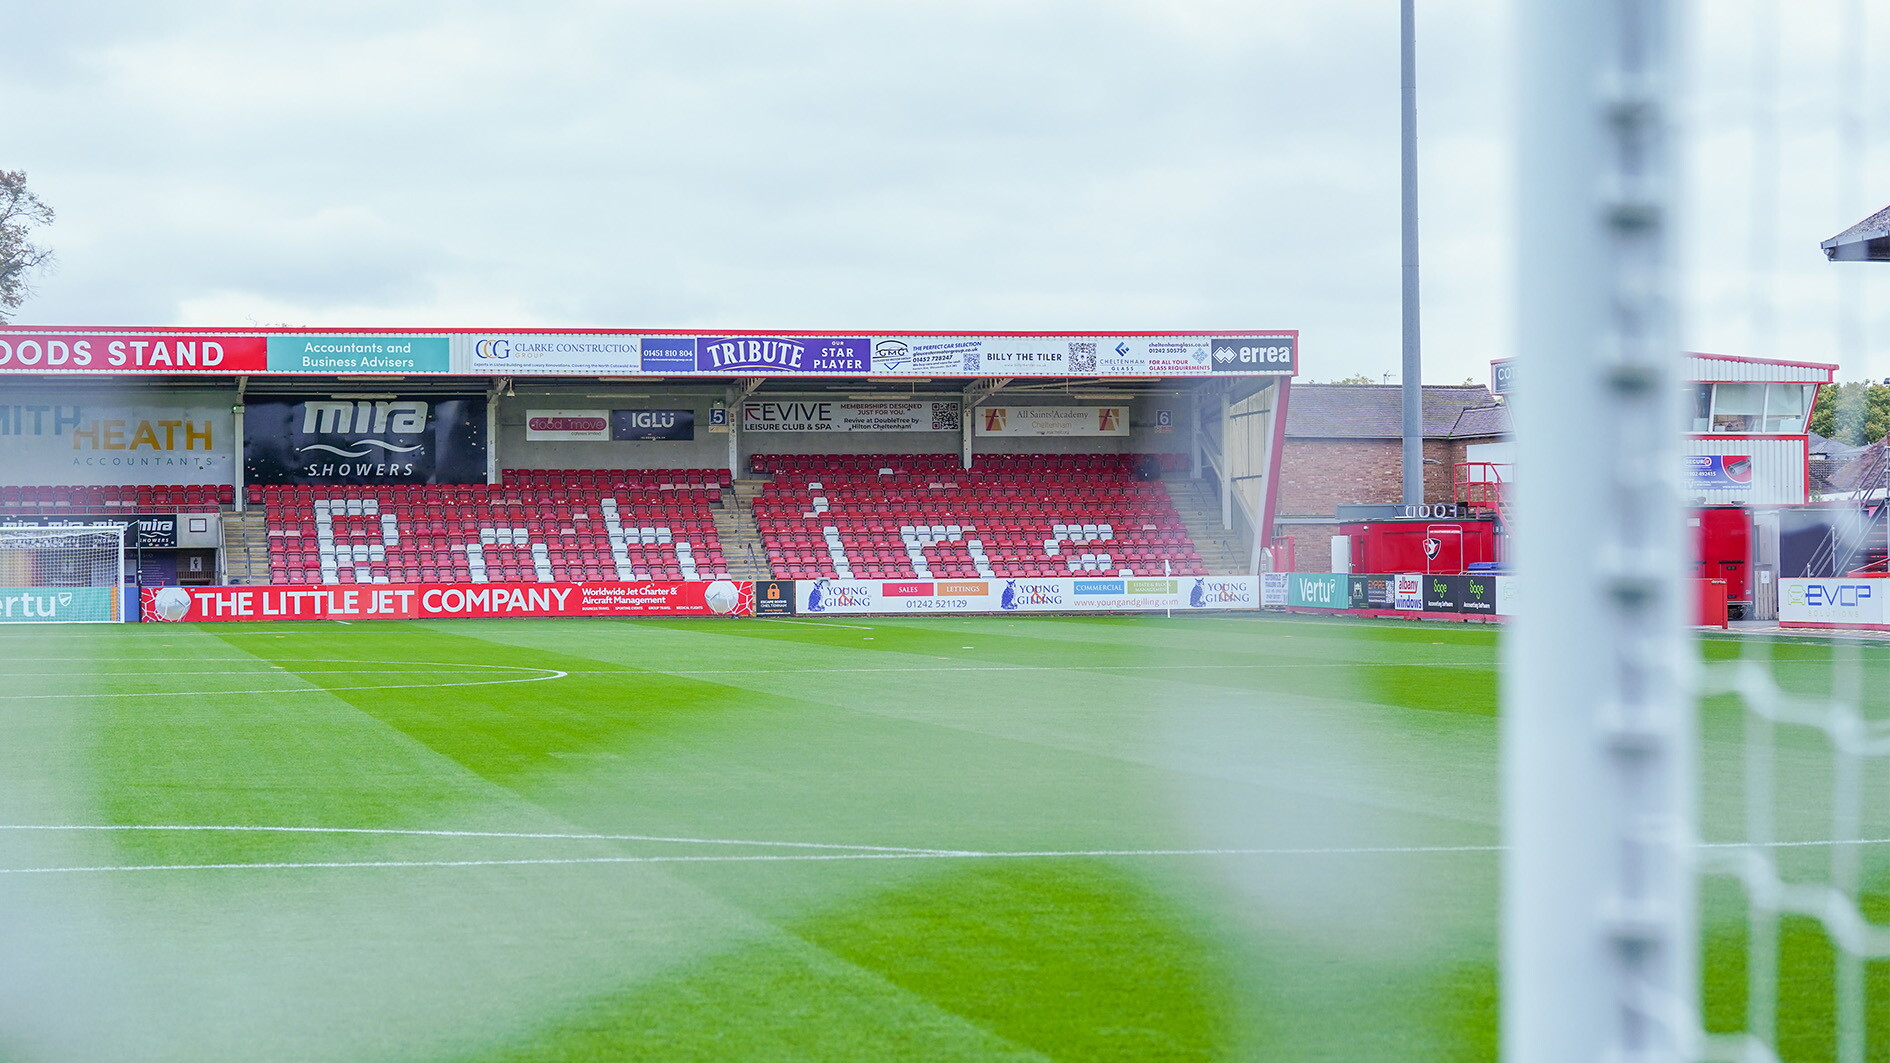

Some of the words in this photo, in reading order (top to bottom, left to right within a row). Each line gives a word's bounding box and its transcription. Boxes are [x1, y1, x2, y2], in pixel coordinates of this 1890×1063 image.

[304, 342, 383, 353] Accountants
[386, 342, 411, 353] and
[514, 343, 554, 352] CLARKE
[556, 344, 637, 353] CONSTRUCTION
[821, 347, 854, 357] STAR
[108, 341, 224, 366] STAND
[643, 349, 663, 357] 01451
[664, 349, 678, 357] 810
[679, 349, 693, 357] 804
[706, 340, 805, 368] TRIBUTE
[987, 353, 1013, 361] BILLY
[1016, 353, 1034, 361] THE
[1037, 353, 1062, 361] TILER
[302, 356, 357, 367] Business
[360, 356, 415, 367] Advisers
[813, 359, 863, 369] PLAYER
[713, 410, 723, 424] 5
[744, 403, 832, 421] REVIVE
[1016, 410, 1029, 419] All
[1053, 410, 1089, 420] Academy
[302, 401, 429, 434] mira
[911, 417, 920, 425] by
[1159, 411, 1169, 425] 6
[0, 405, 81, 435] ITH
[73, 420, 212, 450] HEATH
[744, 423, 781, 431] LEISURE
[781, 423, 806, 431] CLUB
[73, 457, 213, 466] ACCOUNTANTS
[307, 463, 414, 477] SHOWERS
[139, 518, 173, 531] mira
[1019, 585, 1060, 594] YOUNG
[1075, 584, 1123, 592] COMMERCIAL
[1207, 583, 1247, 592] YOUNG
[1398, 577, 1419, 592] albany
[1433, 578, 1448, 599] Sage
[1469, 579, 1484, 600] Sage
[581, 588, 625, 596] Worldwide
[640, 587, 670, 595] Charter
[827, 586, 868, 596] YOUNG
[1299, 578, 1331, 603] Vertu
[195, 592, 254, 616] THE
[263, 591, 360, 615] LITTLE
[366, 590, 416, 614] JET
[422, 588, 573, 614] COMPANY
[581, 596, 613, 605] Aircraft
[613, 596, 666, 605] Management
[824, 598, 871, 607] GILLING
[1017, 595, 1062, 605] GILLING
[1073, 598, 1179, 608] www.youngandgilling.com
[1205, 593, 1249, 603] GILLING
[1395, 595, 1422, 609] windows
[0, 592, 56, 617] rtu
[906, 600, 933, 608] 01242
[935, 600, 968, 608] 521129
[1808, 610, 1860, 618] SOLUTIONS
